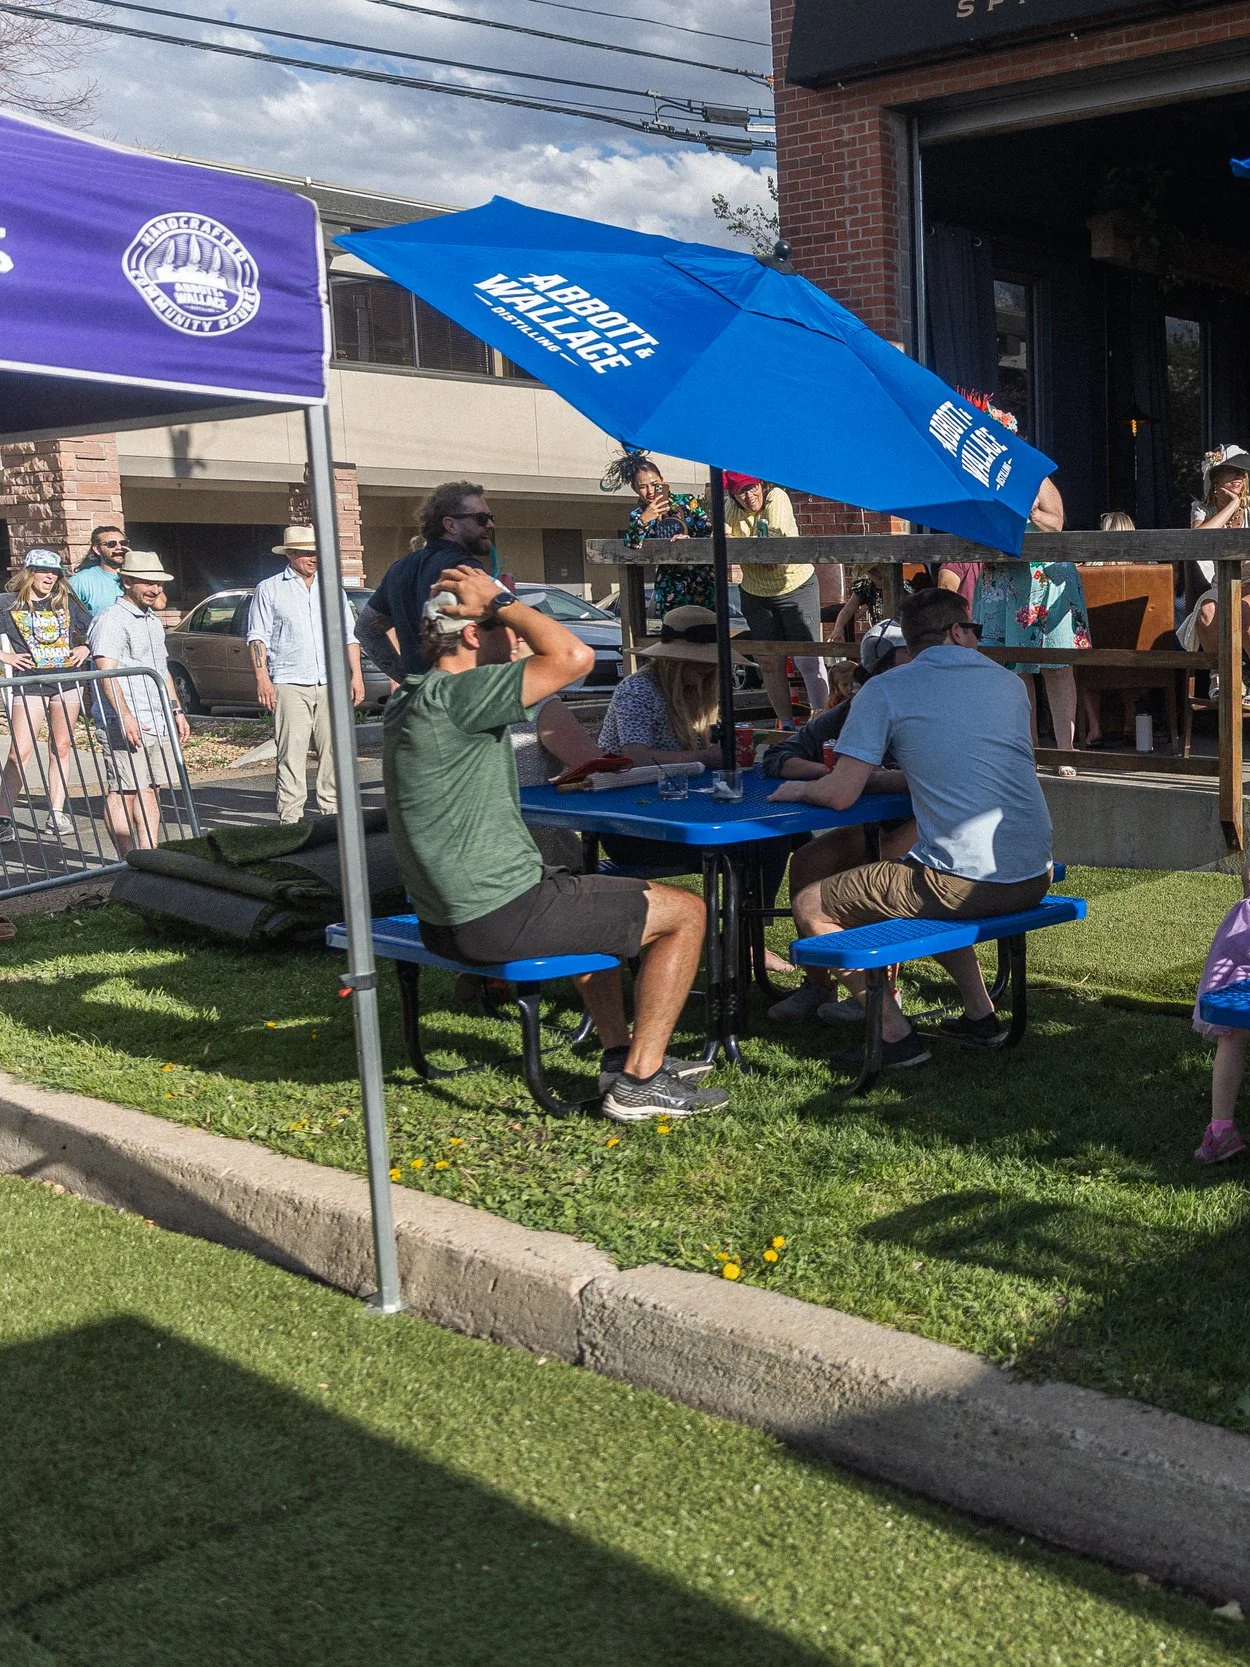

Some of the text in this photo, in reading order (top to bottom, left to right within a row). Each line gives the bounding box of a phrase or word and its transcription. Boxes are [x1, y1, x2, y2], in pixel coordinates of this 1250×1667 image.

[140, 216, 247, 262] HANDCRAFTED
[130, 269, 213, 332] COMMUNITY
[473, 273, 632, 374] WALLACE
[490, 306, 563, 353] DISTILLING
[518, 272, 660, 360] ABBOTT &
[961, 426, 1009, 488] WALLACE
